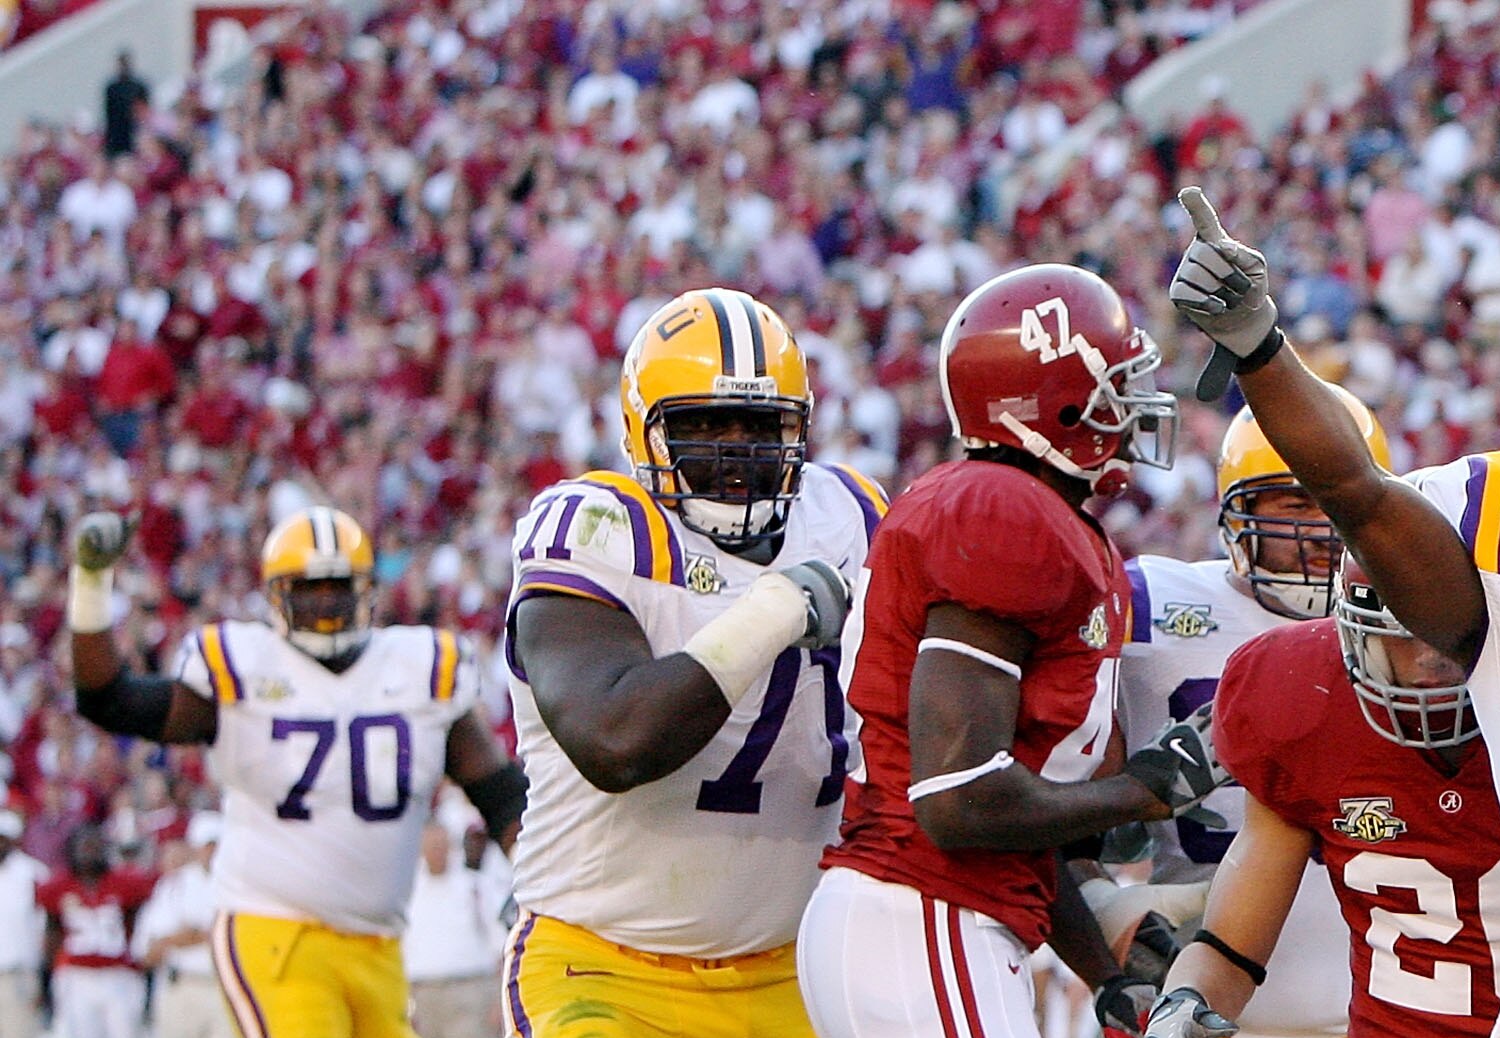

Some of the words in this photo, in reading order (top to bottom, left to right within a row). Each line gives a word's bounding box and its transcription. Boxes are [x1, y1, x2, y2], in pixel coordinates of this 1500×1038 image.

[1021, 298, 1076, 364] 47
[730, 381, 760, 391] TIGERS
[1174, 612, 1200, 637] SEC
[271, 713, 411, 821] 70
[1356, 813, 1386, 841] SEC
